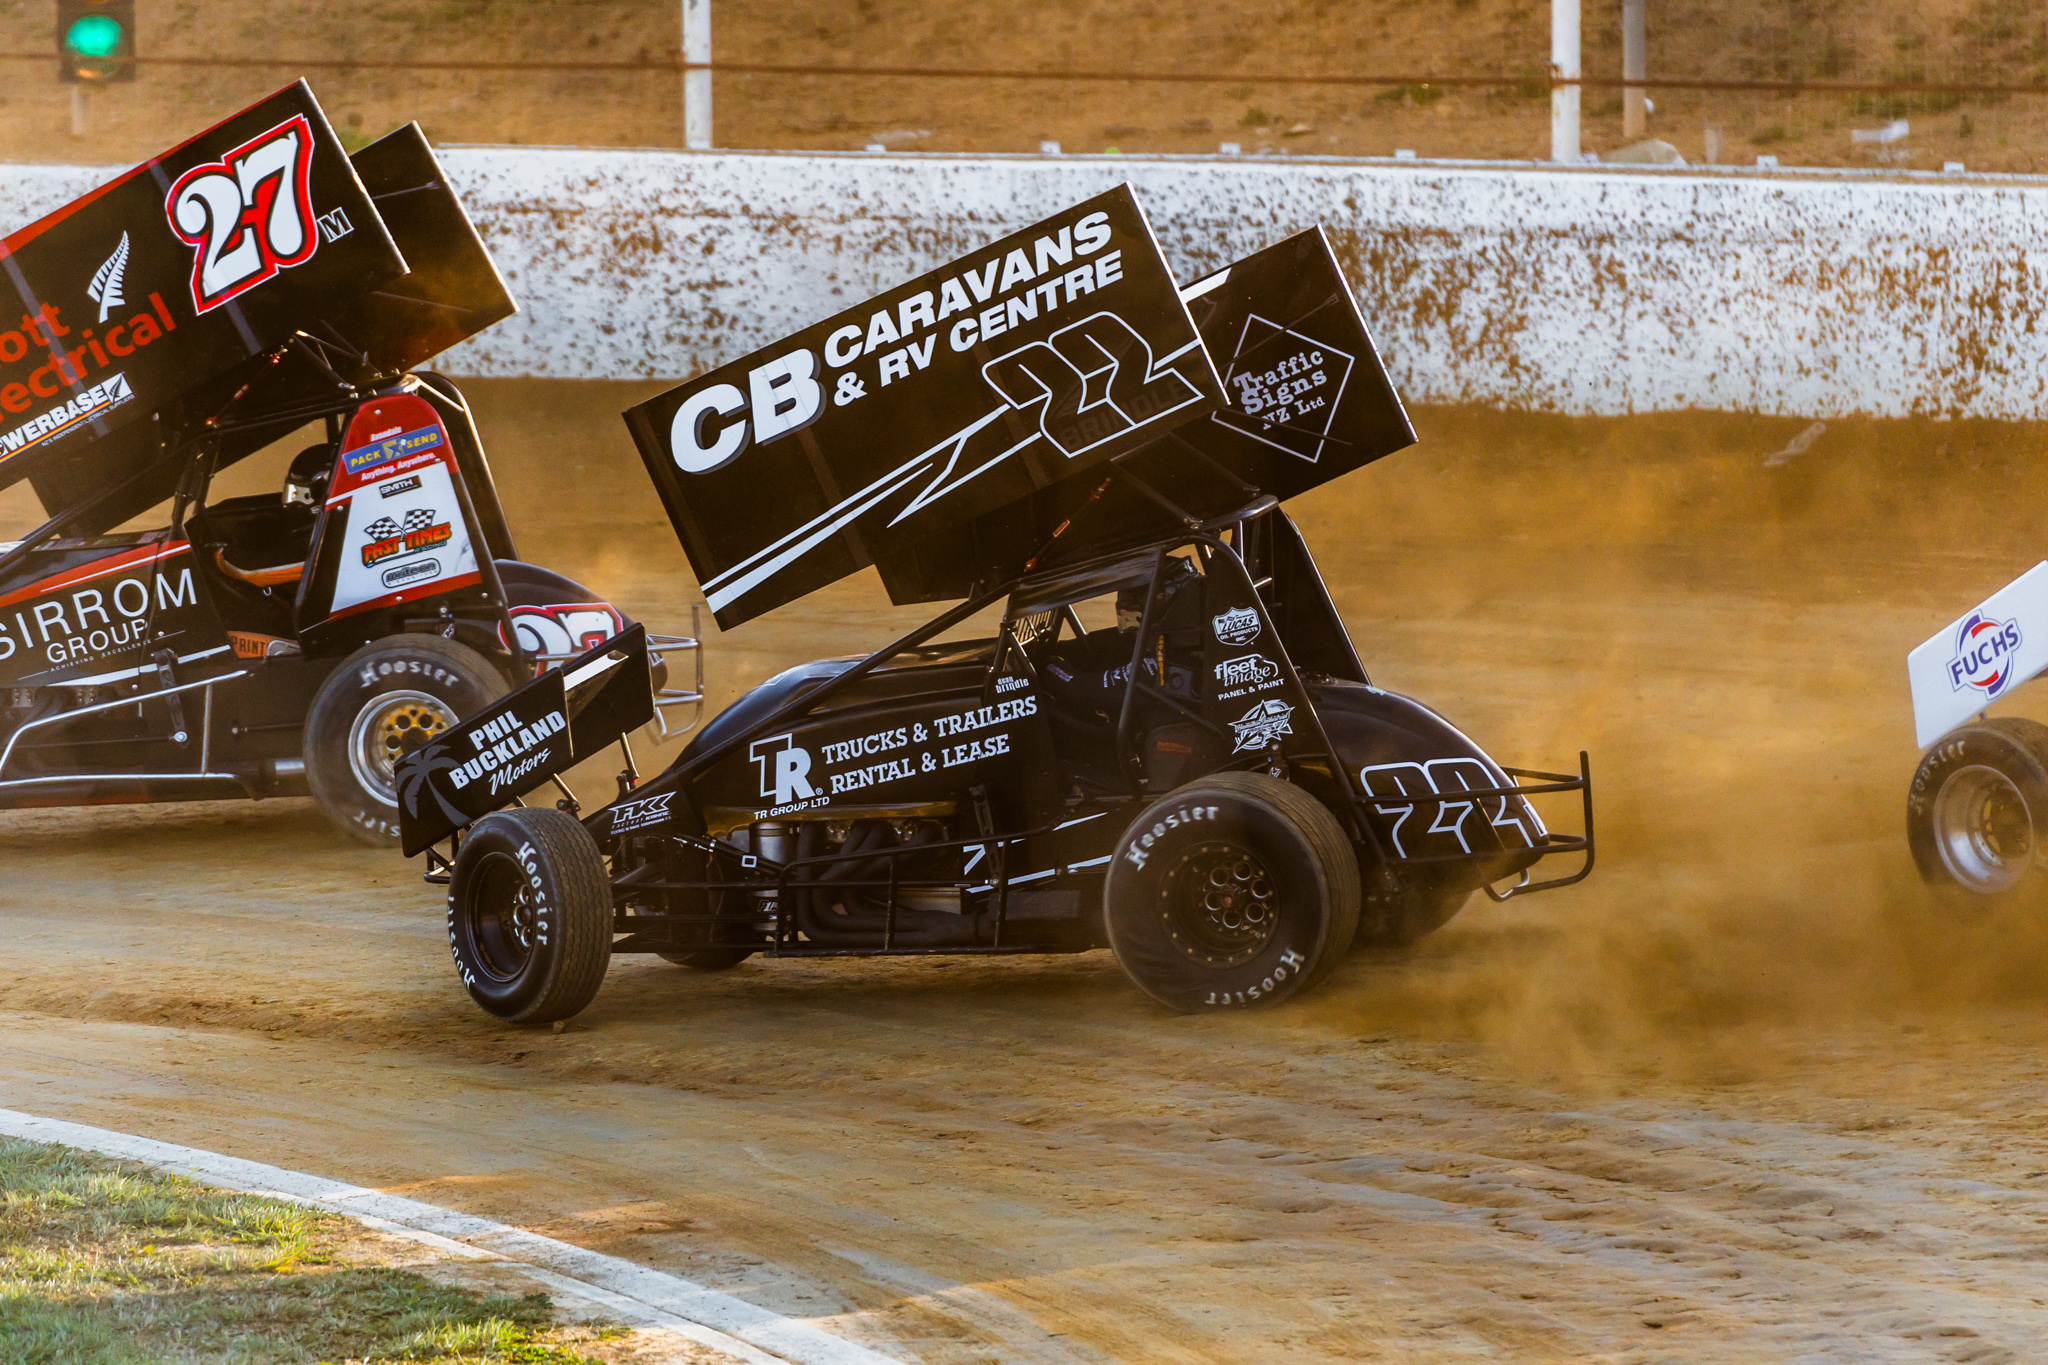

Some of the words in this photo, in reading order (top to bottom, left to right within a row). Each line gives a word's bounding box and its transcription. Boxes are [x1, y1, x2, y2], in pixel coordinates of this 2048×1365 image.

[170, 121, 311, 307] 27
[316, 207, 354, 243] M
[824, 211, 1112, 368] CARAVANS
[834, 371, 867, 406] &
[878, 333, 937, 387] RV
[949, 249, 1124, 352] CENTRE
[0, 291, 177, 422] ectrical
[1232, 351, 1324, 393] Traffic
[982, 311, 1205, 459] 22
[1240, 370, 1327, 414] Signs
[86, 407, 109, 424] LECTRICAL
[671, 349, 823, 473] CB
[1261, 407, 1291, 430] NZ
[1294, 396, 1326, 415] Ltd
[351, 450, 382, 467] PACK
[406, 433, 438, 449] SEND
[371, 426, 402, 442] Avondale
[361, 464, 396, 481] Anything.
[397, 452, 436, 470] Anywhere.
[380, 479, 413, 494] SMITH
[362, 537, 401, 565] FAST
[404, 522, 452, 551] TIMES
[414, 540, 447, 553] RACING
[0, 568, 197, 660] SIRROM
[1222, 616, 1255, 632] LUCAS
[1230, 626, 1259, 638] PRODUCTS
[47, 618, 148, 664] GROUP
[51, 656, 95, 672] ACHIEVING
[102, 639, 152, 657] EXCELLENCE
[1951, 623, 2019, 685] FUCHS
[361, 660, 459, 688] Hoosier
[995, 678, 1030, 694] brindle
[997, 676, 1014, 686] dean
[1214, 657, 1257, 680] fleet
[1218, 688, 1247, 700] PANEL
[1257, 678, 1285, 691] PAINT
[1223, 666, 1271, 687] image
[448, 710, 567, 790] BUCKLAND
[468, 710, 523, 751] PHIL
[821, 727, 908, 764] TRUCKS
[912, 723, 928, 742] &
[934, 695, 1038, 737] TRAILERS
[488, 747, 551, 796] Motors
[749, 733, 816, 805] TR
[830, 758, 916, 794] RENTAL
[921, 752, 937, 772] &
[941, 733, 1010, 768] LEASE
[754, 810, 768, 820] TR
[770, 801, 808, 816] GROUP
[811, 796, 830, 808] LTD
[1124, 803, 1219, 872] Hoosier
[514, 841, 553, 946] Hoosier
